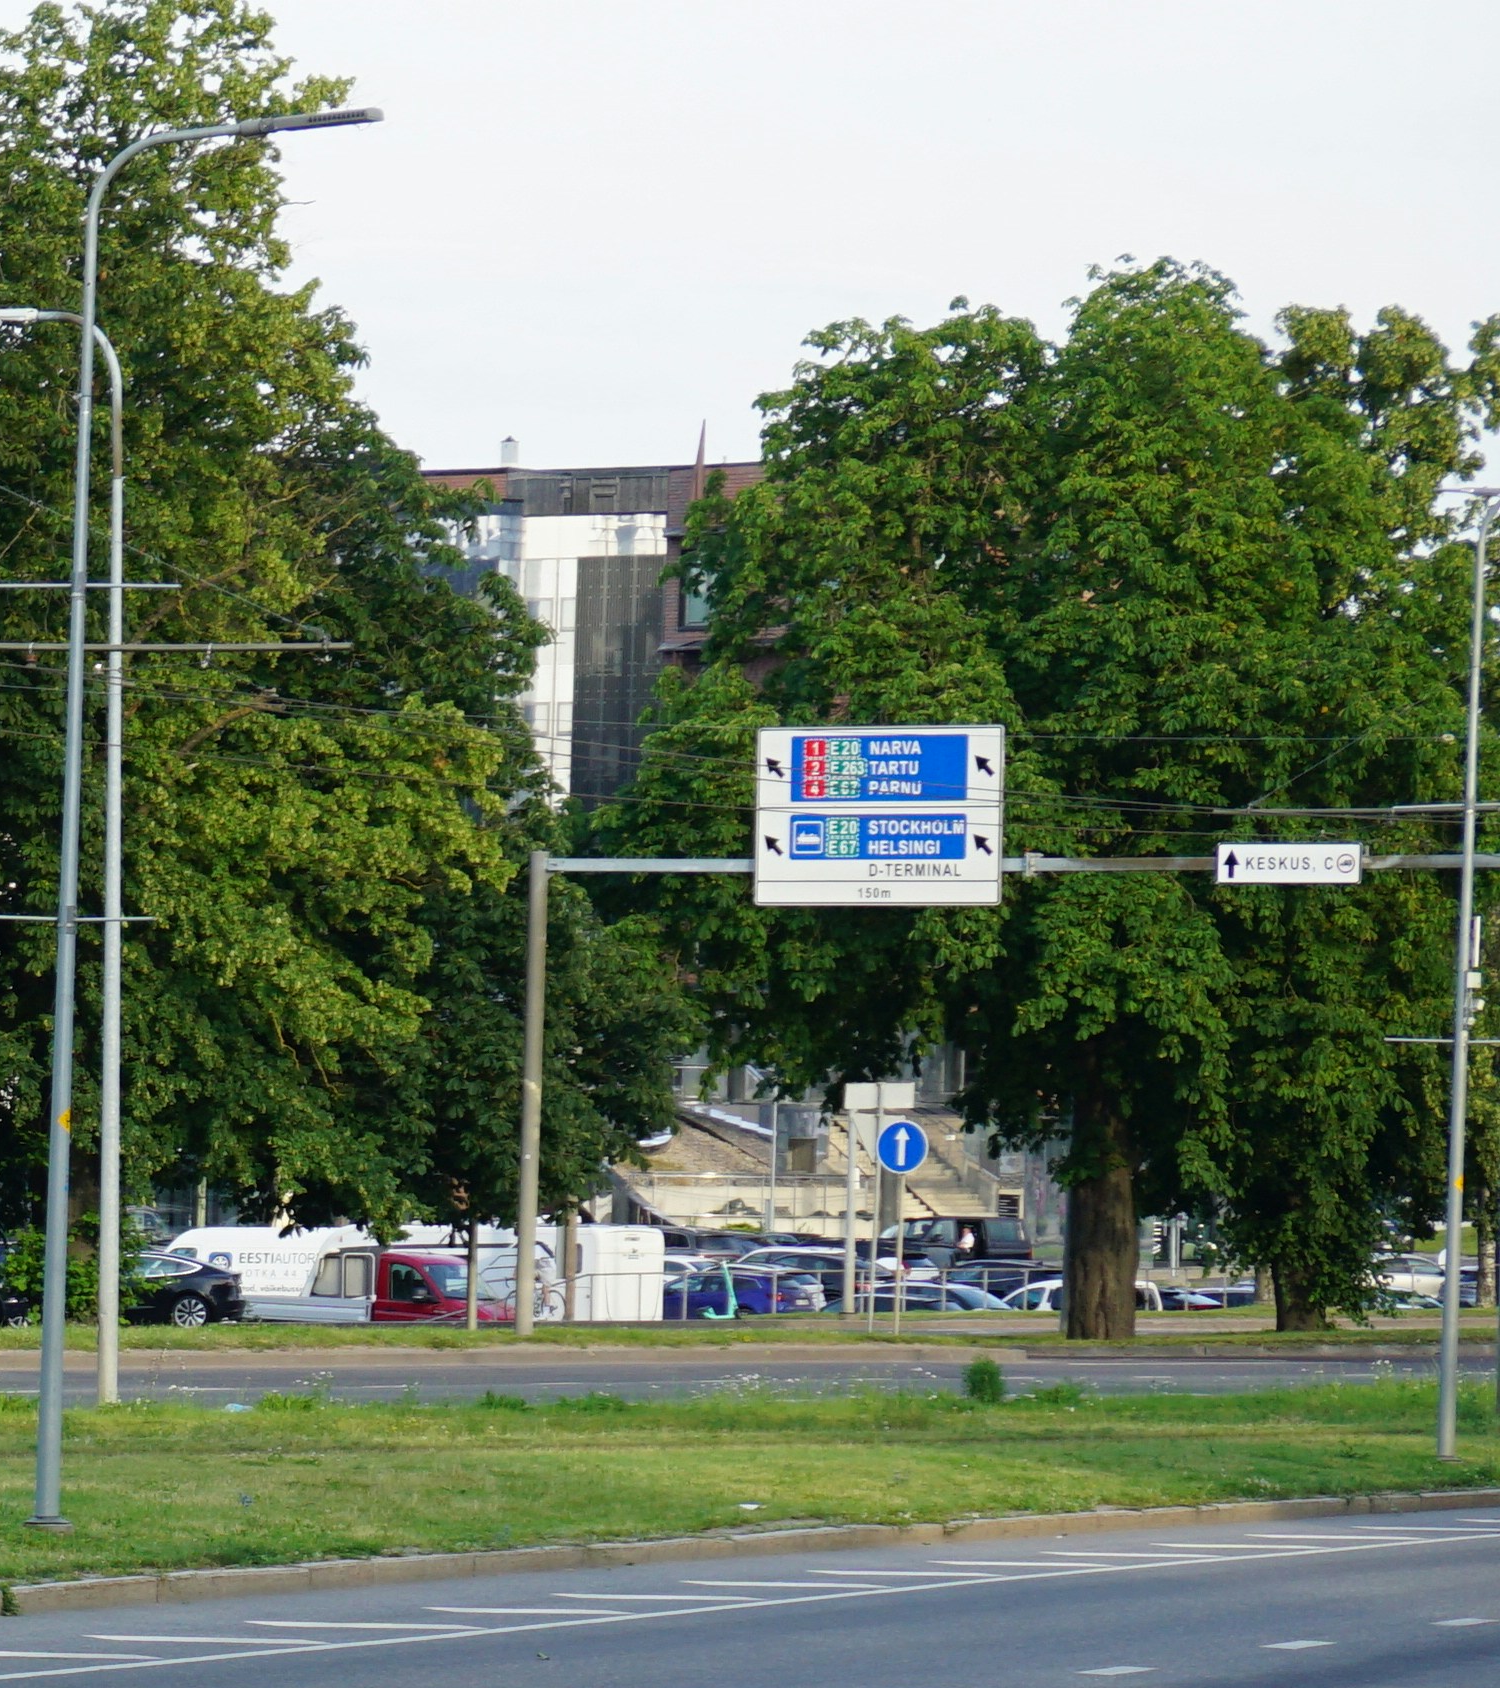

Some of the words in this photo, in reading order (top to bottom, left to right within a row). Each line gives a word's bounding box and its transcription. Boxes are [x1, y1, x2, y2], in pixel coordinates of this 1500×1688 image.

[811, 742, 820, 755] 1
[869, 740, 922, 755] NARVA
[869, 760, 919, 775] TARTU
[868, 820, 964, 835] STOCKHOLM
[868, 840, 941, 855] HELSINGI
[869, 863, 962, 877] D-TERMINAL
[1245, 856, 1316, 872] KESKUS,
[1324, 856, 1333, 870] C
[239, 1252, 318, 1265] EESTIAUTOR
